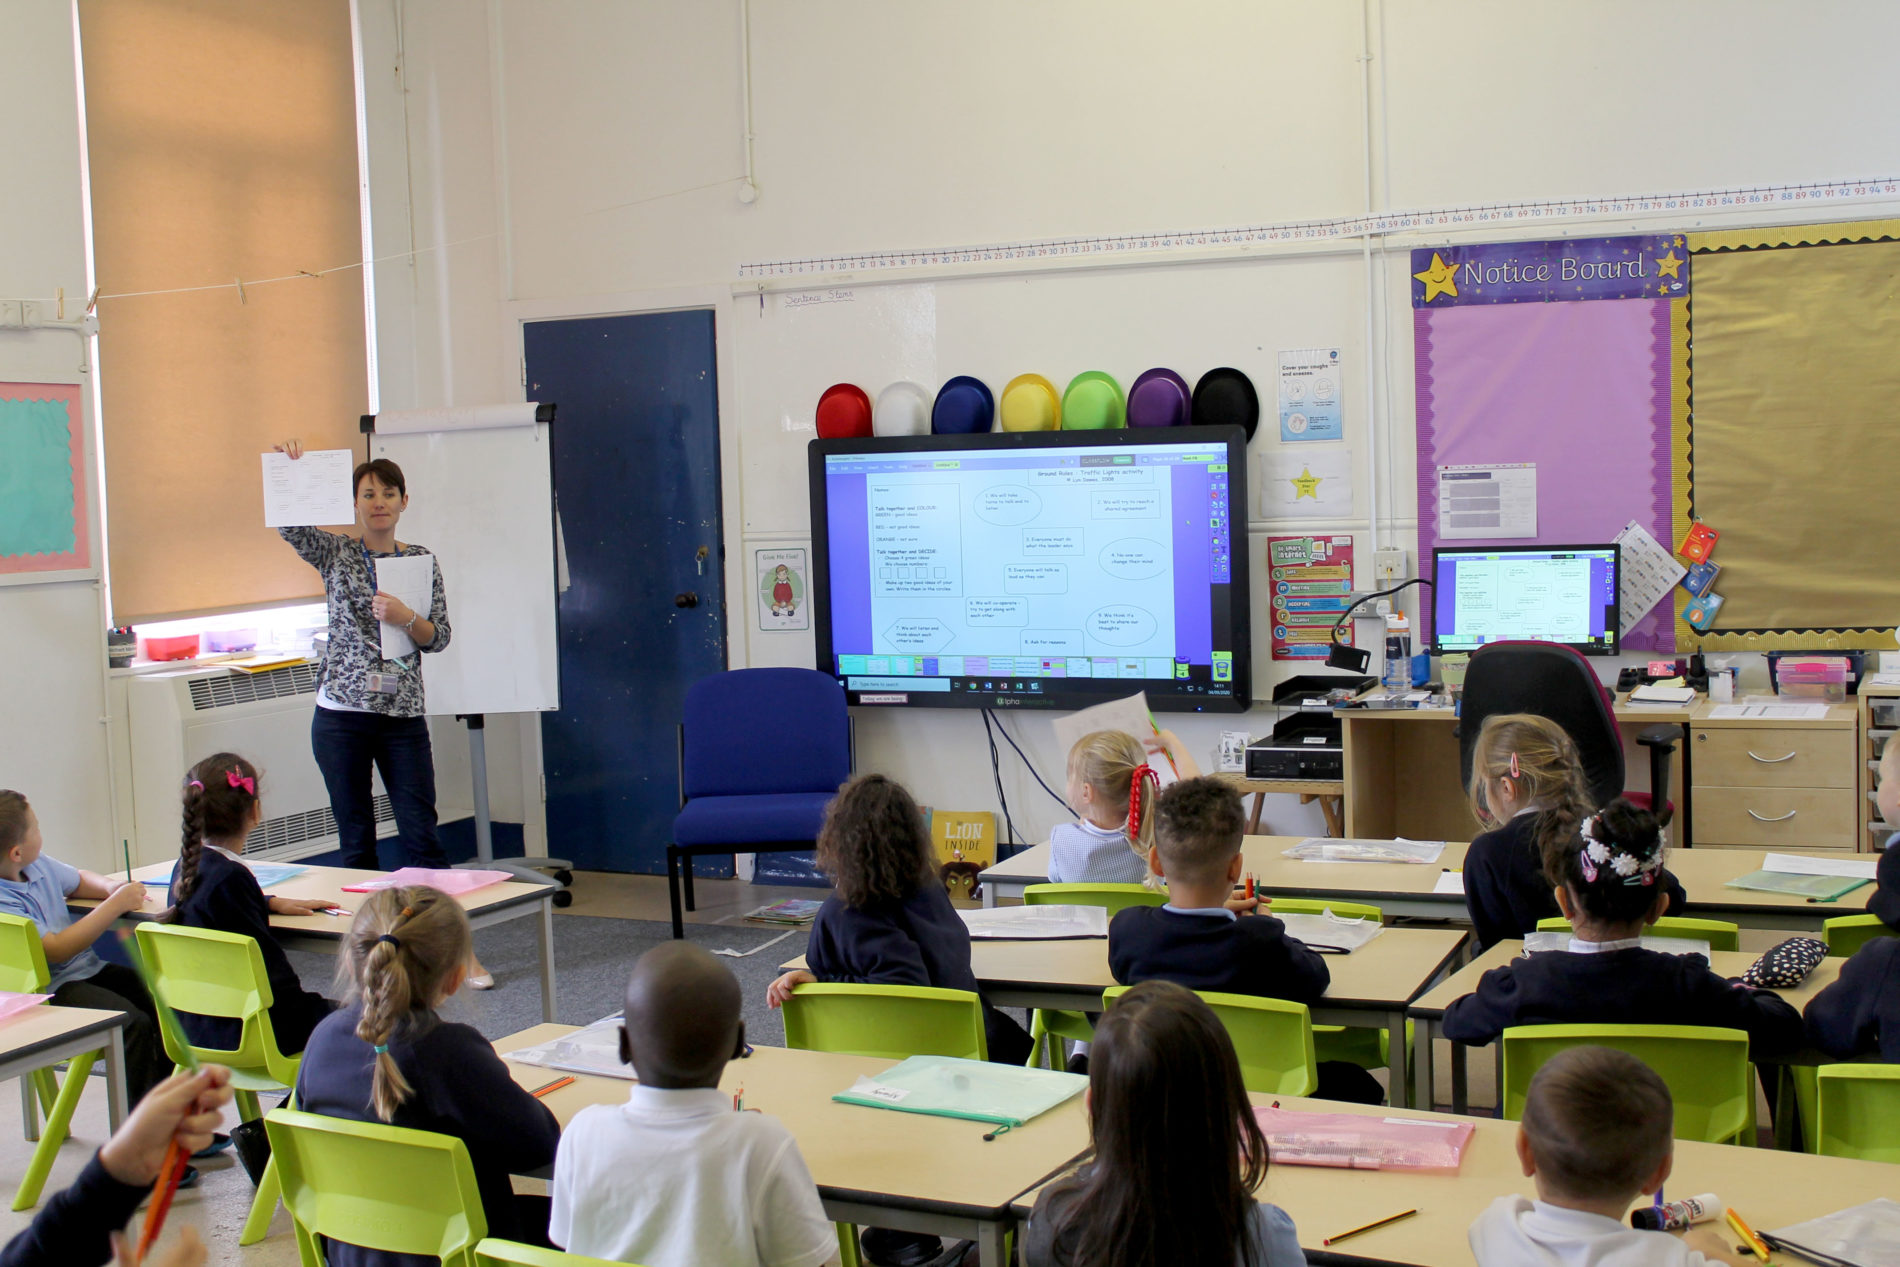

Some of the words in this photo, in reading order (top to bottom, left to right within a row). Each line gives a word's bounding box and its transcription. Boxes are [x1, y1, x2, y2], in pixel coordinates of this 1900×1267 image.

[1363, 223, 1373, 231] 57
[1518, 209, 1528, 217] 69
[1556, 207, 1568, 215] 72
[1573, 205, 1583, 214] 73
[1693, 199, 1704, 207] 82
[1706, 198, 1717, 206] 83
[1763, 194, 1774, 202] 87
[1839, 188, 1851, 196] 92
[1869, 186, 1881, 194] 94
[1464, 259, 1553, 285] Notice
[1560, 252, 1648, 281] Board
[785, 293, 821, 304] Sentence
[945, 840, 980, 850] INSIDE
[1688, 1199, 1701, 1214] Pritt
